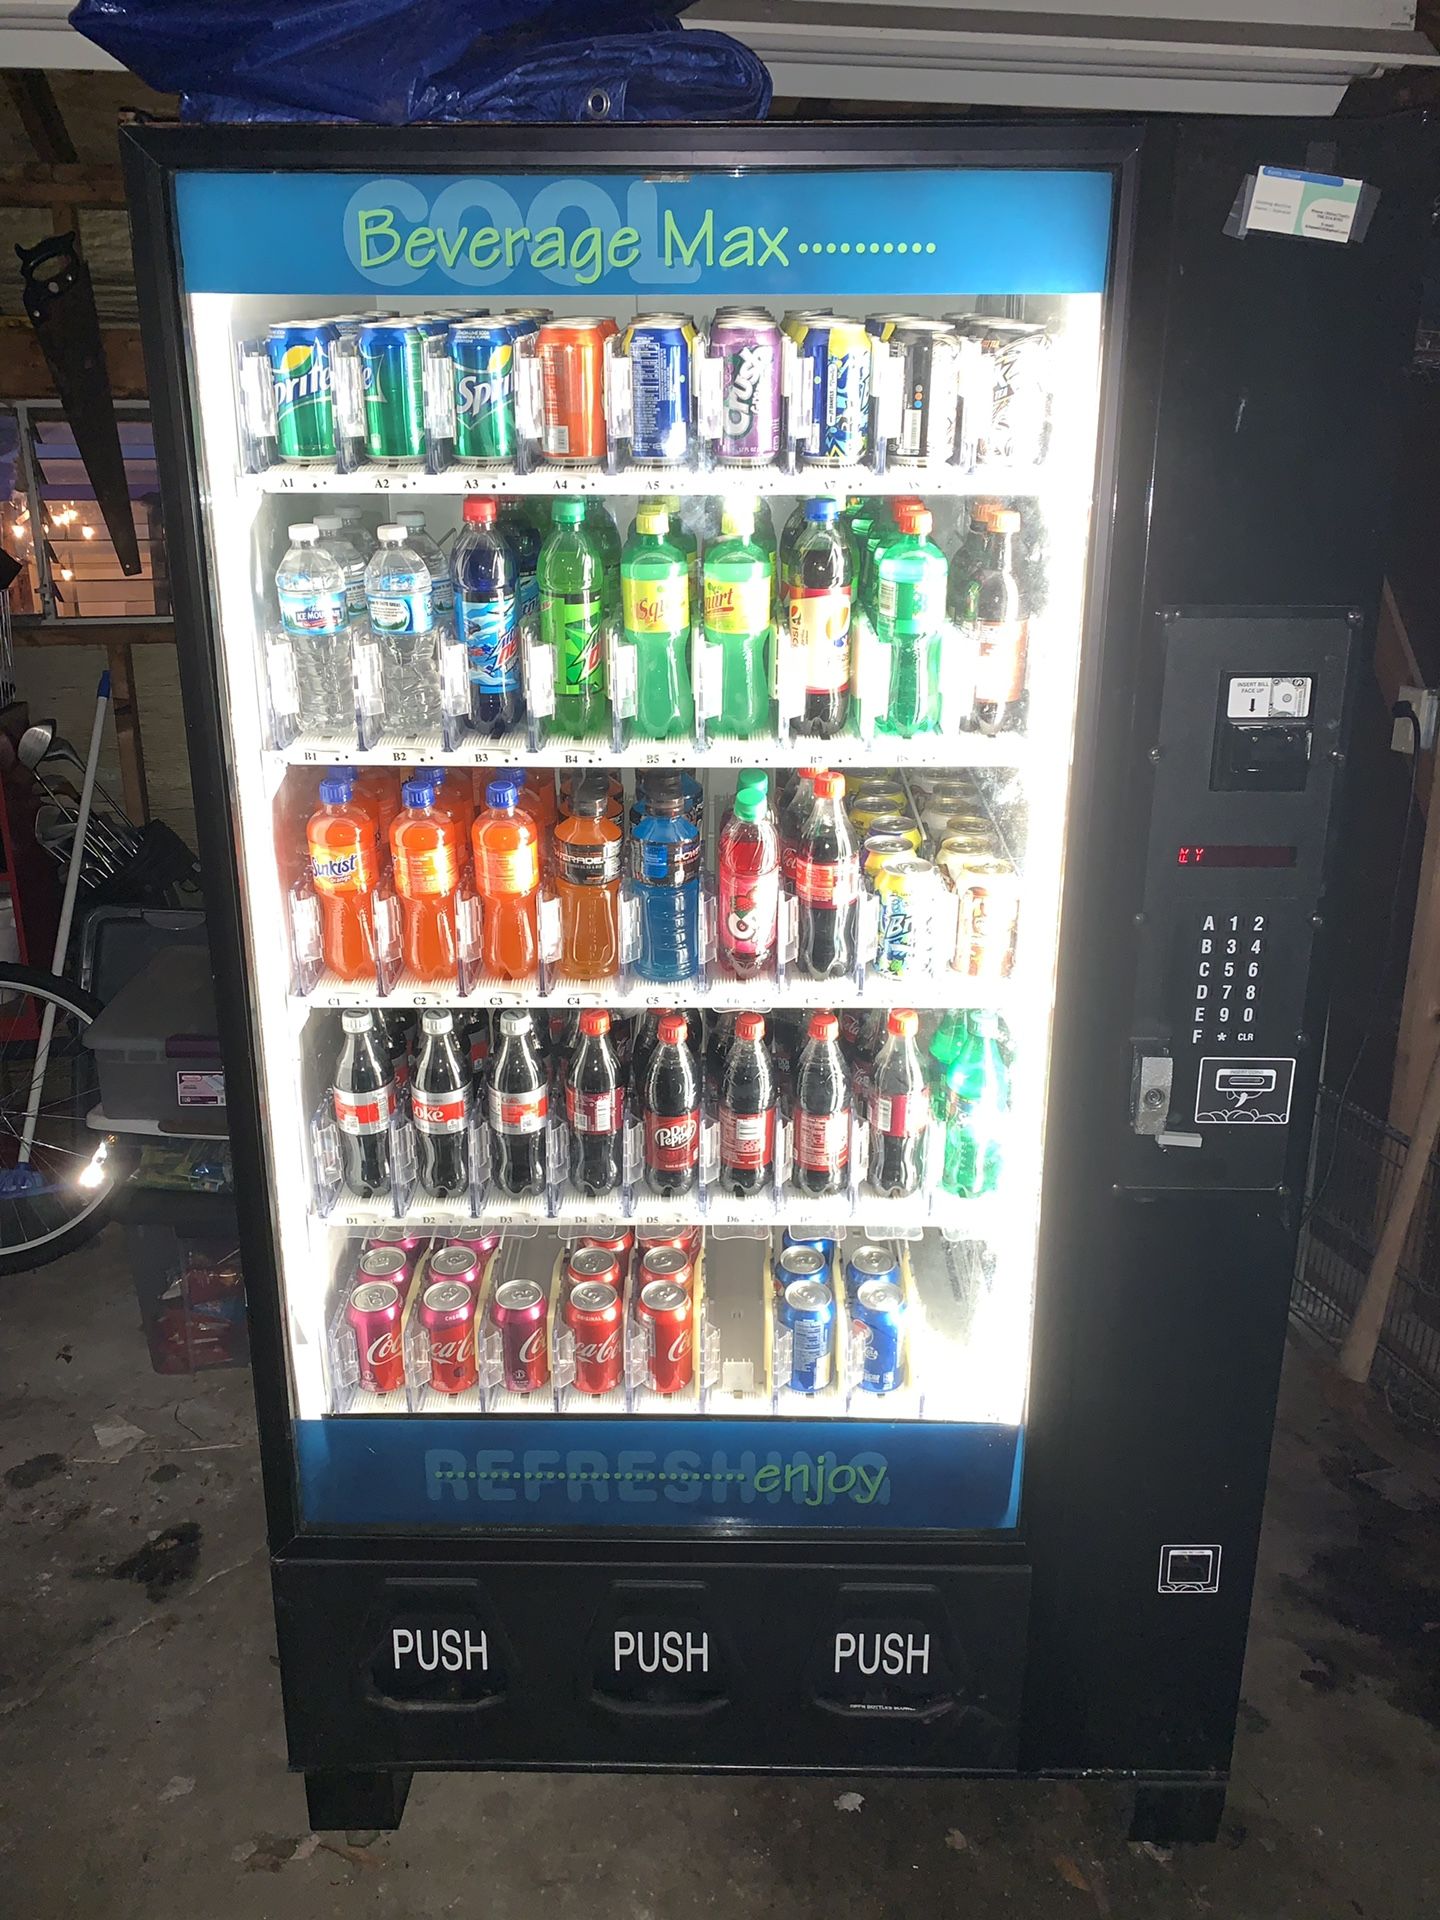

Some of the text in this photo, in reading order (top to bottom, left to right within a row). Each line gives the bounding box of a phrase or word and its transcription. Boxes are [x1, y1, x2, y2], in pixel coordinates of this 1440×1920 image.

[357, 208, 790, 285] Beverage Max
[273, 338, 332, 409] prite
[457, 373, 514, 417] Spri
[280, 479, 294, 488] A1
[374, 479, 389, 489] A2
[464, 479, 479, 489] A3
[553, 479, 568, 489] A4
[645, 480, 660, 490] A5
[304, 752, 317, 761] B1
[393, 752, 407, 761] B2
[475, 753, 488, 762] B3
[565, 755, 578, 764] B4
[646, 755, 660, 764] B5
[730, 755, 743, 764] B6
[310, 854, 357, 877] Sunkist
[1203, 916, 1264, 931] A 1 2
[1201, 939, 1261, 954] B 3 4
[1199, 962, 1258, 977] C 5 6
[1196, 985, 1256, 1000] D 7 8
[328, 998, 341, 1006] C1
[413, 997, 427, 1006] C2
[489, 997, 503, 1006] C3
[567, 997, 580, 1006] C4
[646, 997, 659, 1006] C5
[1195, 1007, 1205, 1022] E
[1219, 1007, 1229, 1022] 9
[1192, 1030, 1254, 1043] F CLR
[414, 1105, 444, 1122] oke
[346, 1217, 359, 1225] D1
[422, 1217, 436, 1225] D2
[499, 1216, 513, 1225] D3
[575, 1216, 588, 1225] D4
[646, 1216, 659, 1224] D5
[727, 1215, 740, 1224] D6
[424, 1449, 891, 1505] REFRESHING
[754, 1455, 888, 1507] enjoy
[392, 1629, 489, 1671] PUSH
[614, 1630, 709, 1672] PUSH
[834, 1633, 931, 1674] PUSH
